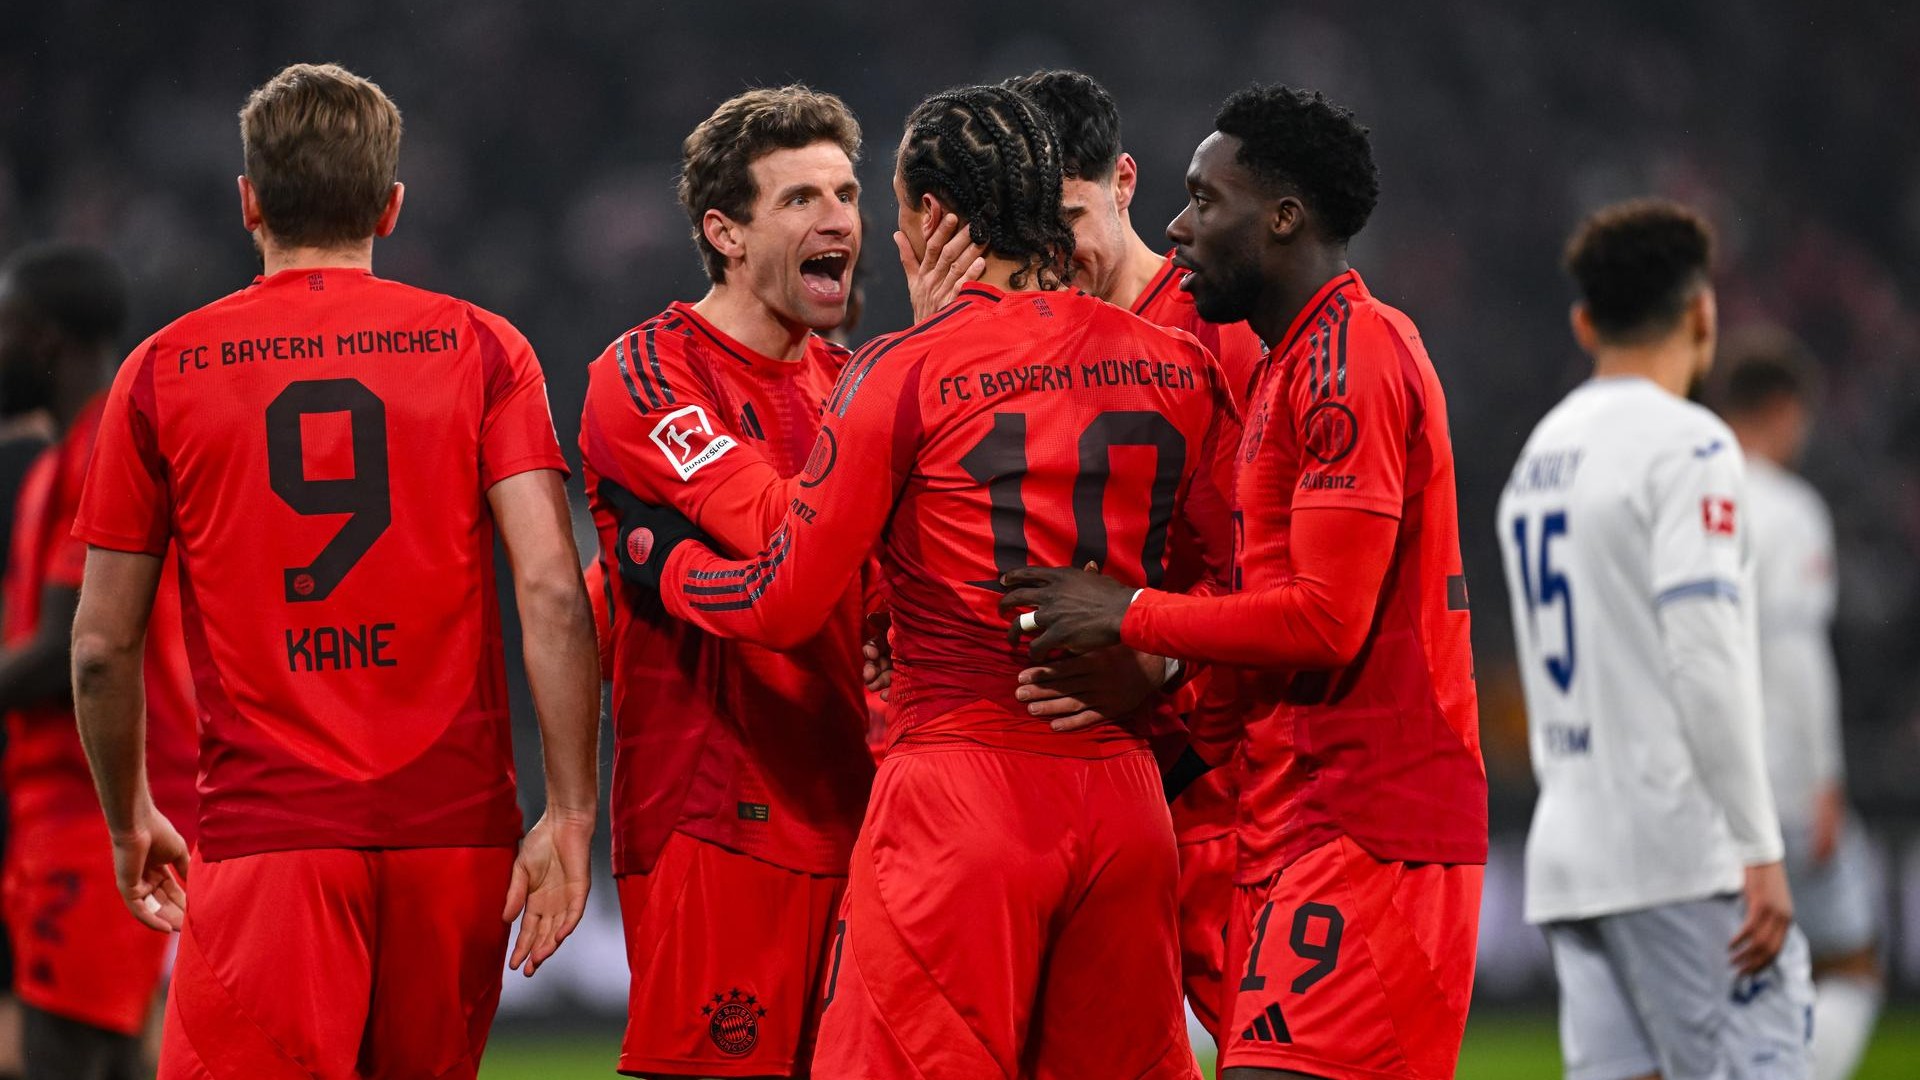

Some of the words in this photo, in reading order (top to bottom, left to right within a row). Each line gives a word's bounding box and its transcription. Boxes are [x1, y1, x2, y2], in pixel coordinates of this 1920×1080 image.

[179, 346, 209, 374] FC
[221, 335, 324, 366] BAYERN
[336, 328, 458, 356] MÜNCHEN
[940, 375, 971, 404] FC
[979, 364, 1073, 398] BAYERN
[1081, 359, 1195, 390] MÜNCHEN
[683, 438, 730, 473] BUNDESLIGA
[265, 378, 392, 603] 9
[958, 410, 1187, 594] 10
[1300, 472, 1357, 489] Allianz
[1512, 510, 1575, 694] 15
[285, 623, 397, 672] KANE
[1239, 901, 1345, 995] 19
